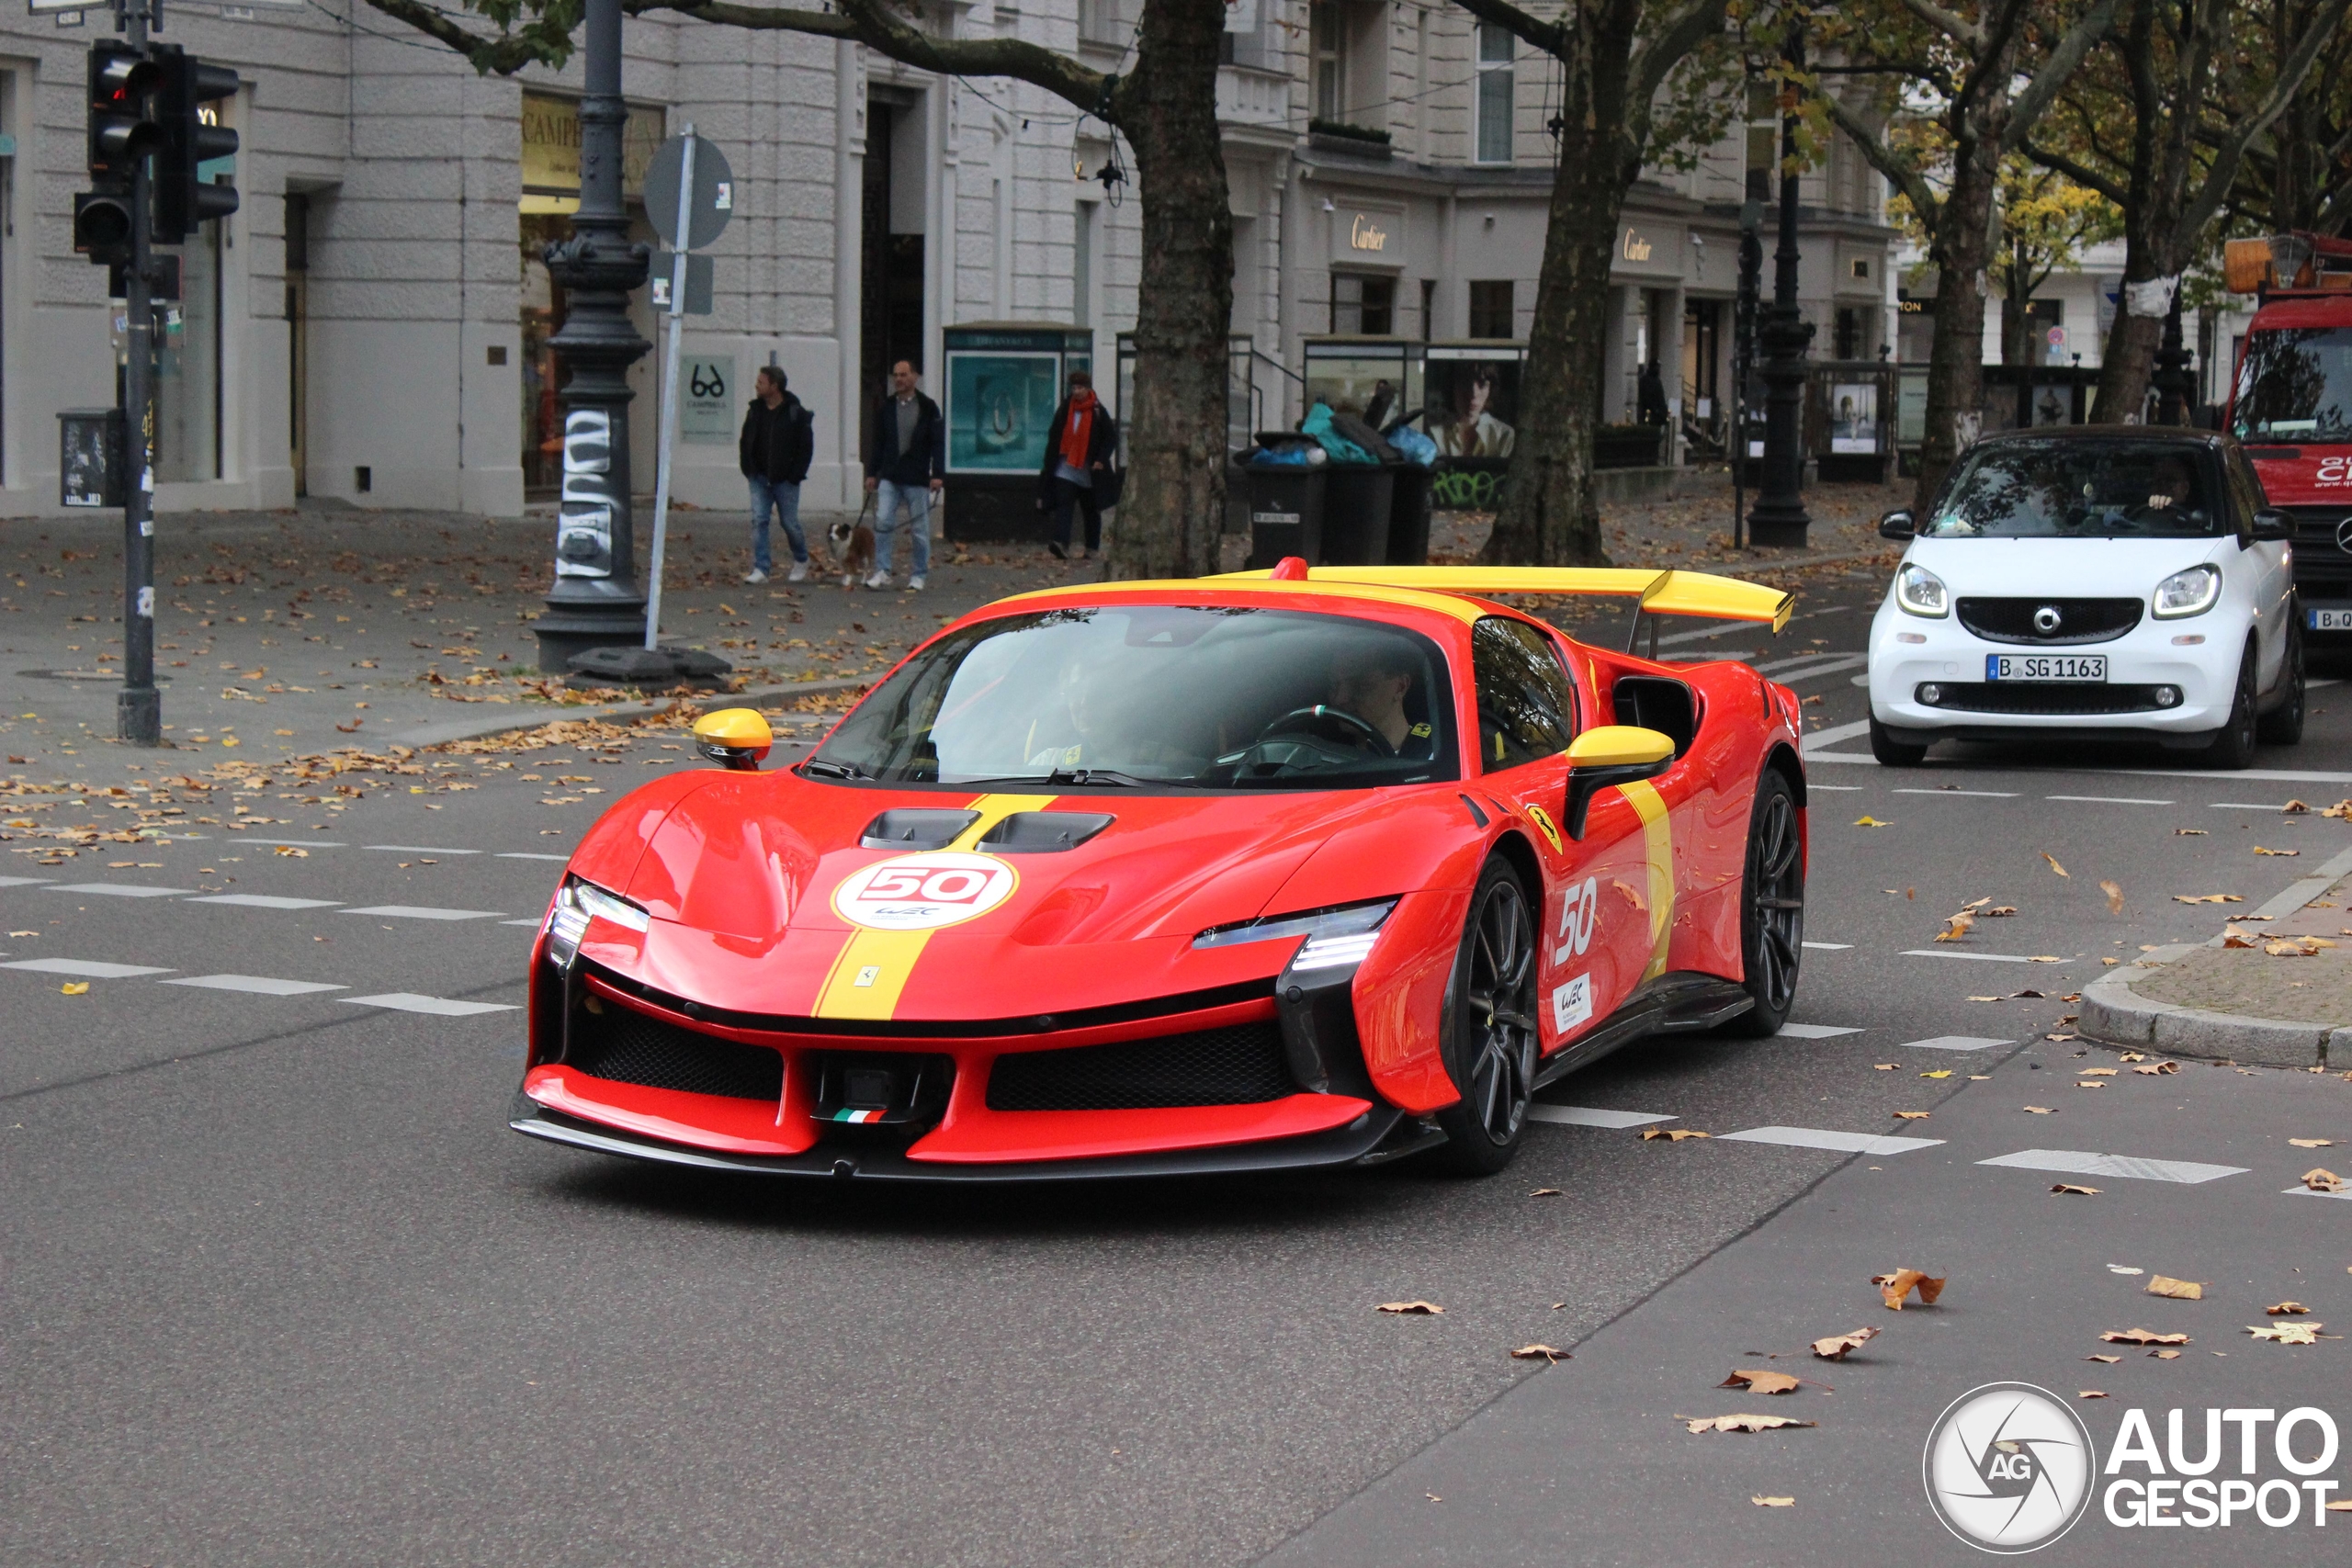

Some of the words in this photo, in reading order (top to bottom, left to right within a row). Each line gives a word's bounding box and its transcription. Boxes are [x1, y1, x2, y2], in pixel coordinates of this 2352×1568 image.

[1351, 214, 1386, 250] Cartier
[1623, 228, 1651, 261] Cartier
[1899, 301, 1921, 312] TON
[2323, 613, 2333, 626] B
[1999, 659, 2011, 677] B
[2025, 659, 2050, 677] SG
[2054, 659, 2102, 677] 1163
[860, 869, 988, 901] 50
[875, 907, 940, 916] WEC
[1555, 876, 1598, 967] 50
[1562, 982, 1583, 1011] WEC
